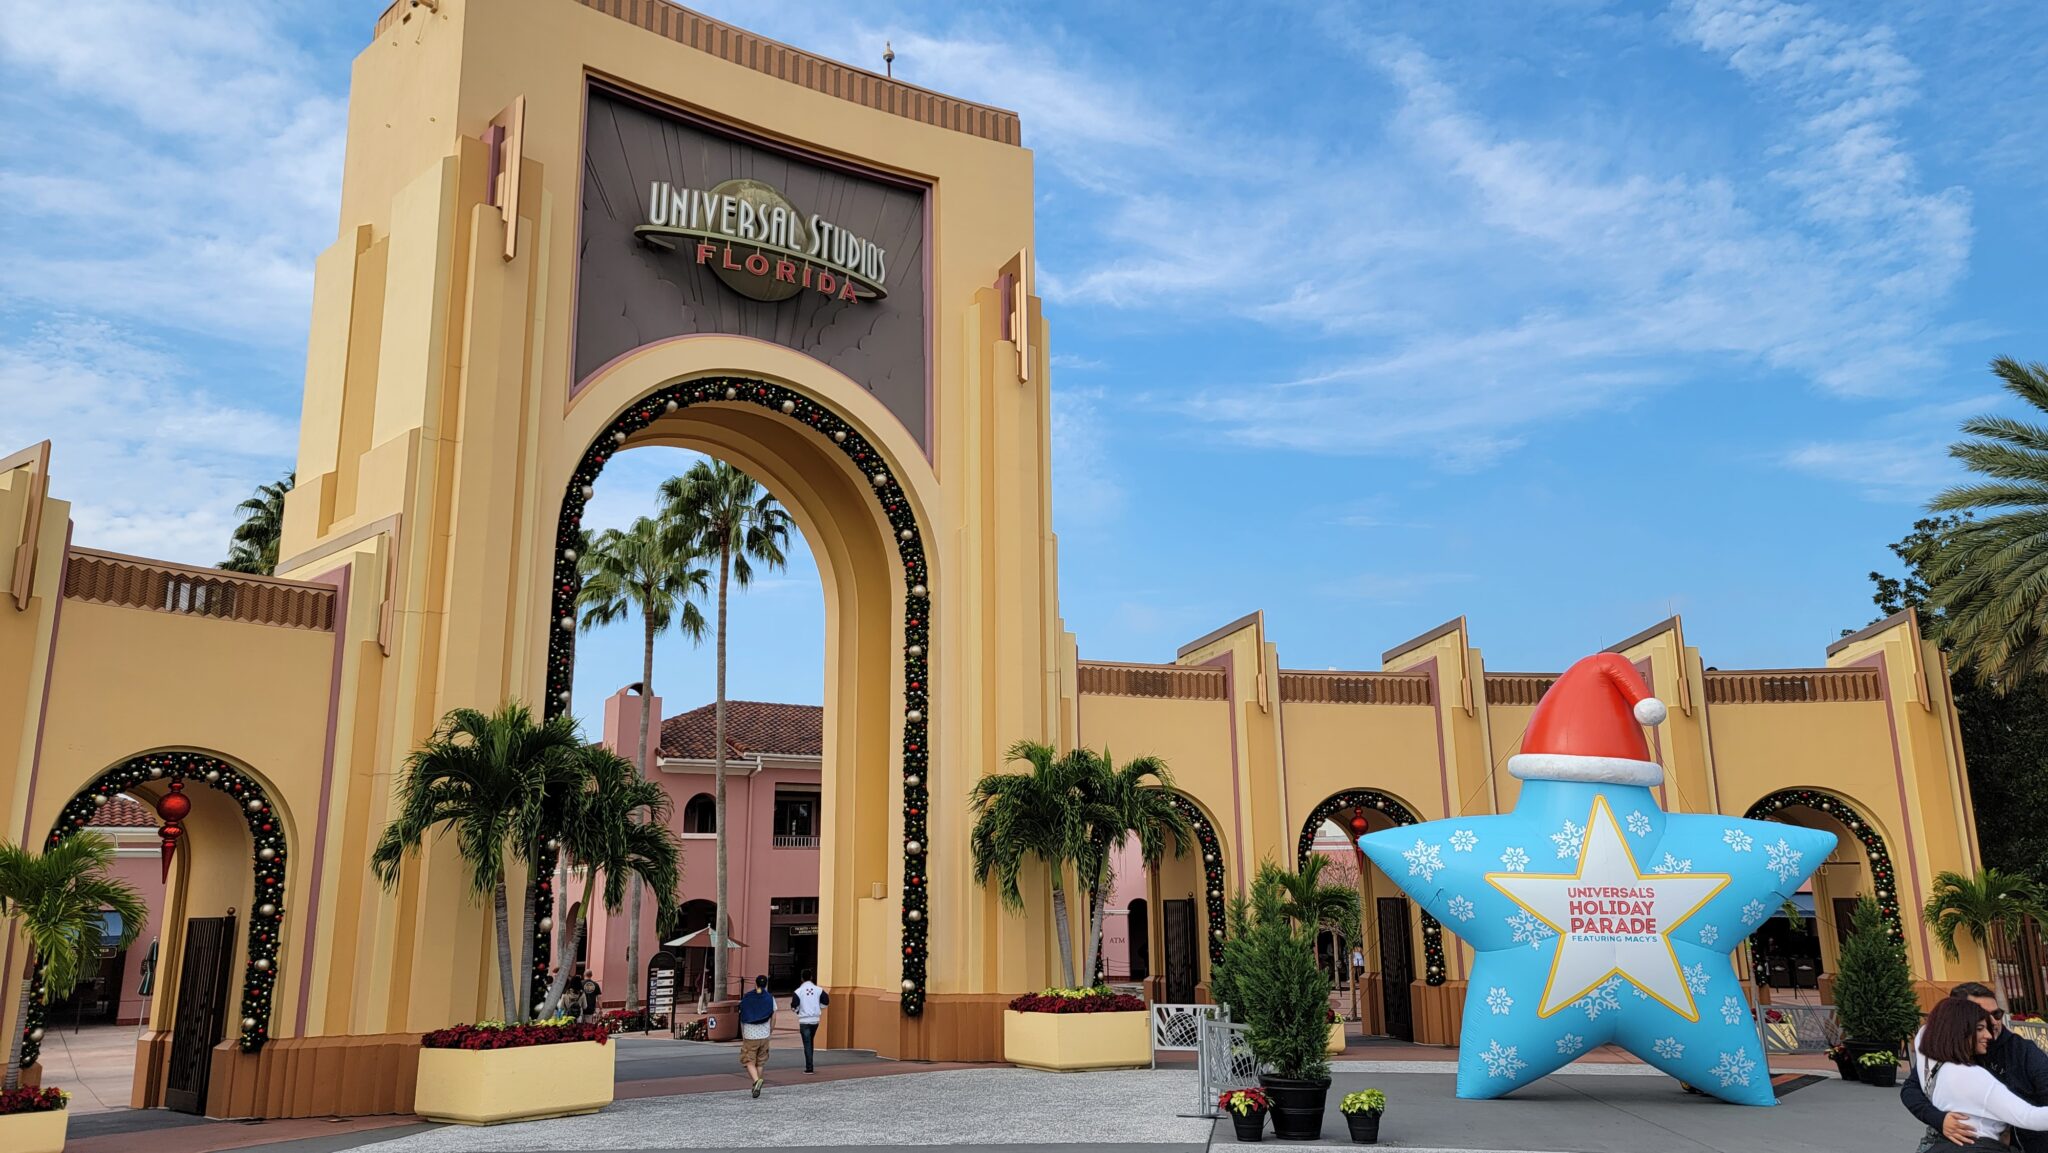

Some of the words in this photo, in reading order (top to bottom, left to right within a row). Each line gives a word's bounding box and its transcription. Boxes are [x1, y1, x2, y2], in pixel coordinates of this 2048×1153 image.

[650, 181, 801, 250] UNIVERSAL
[810, 214, 886, 284] STUDIOS
[697, 244, 858, 304] FLORIDA
[1567, 887, 1655, 899] UNIVERSAL'S
[1569, 901, 1655, 915] HOLIDAY
[1570, 917, 1657, 934] PARADE
